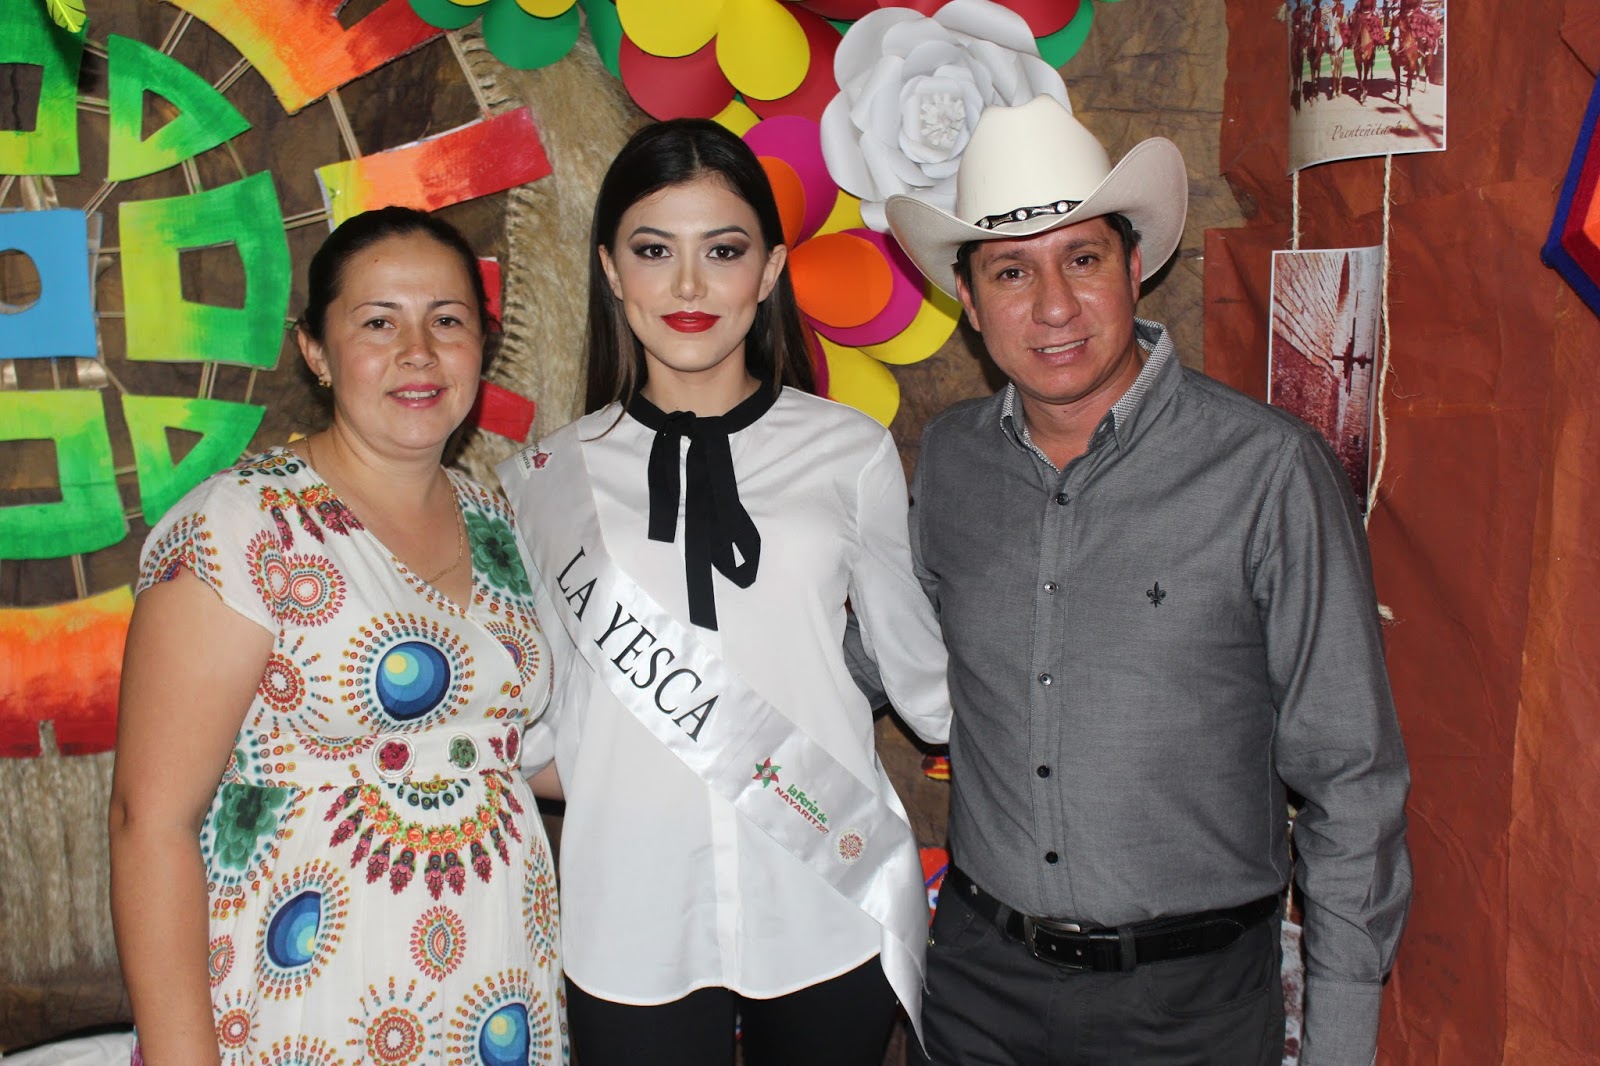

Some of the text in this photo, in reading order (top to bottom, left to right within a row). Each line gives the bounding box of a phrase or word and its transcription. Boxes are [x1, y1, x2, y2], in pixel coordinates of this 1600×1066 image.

[556, 546, 719, 742] LA YESCA
[774, 786, 819, 825] NAYARIT
[795, 791, 819, 815] Feria
[817, 813, 828, 824] de
